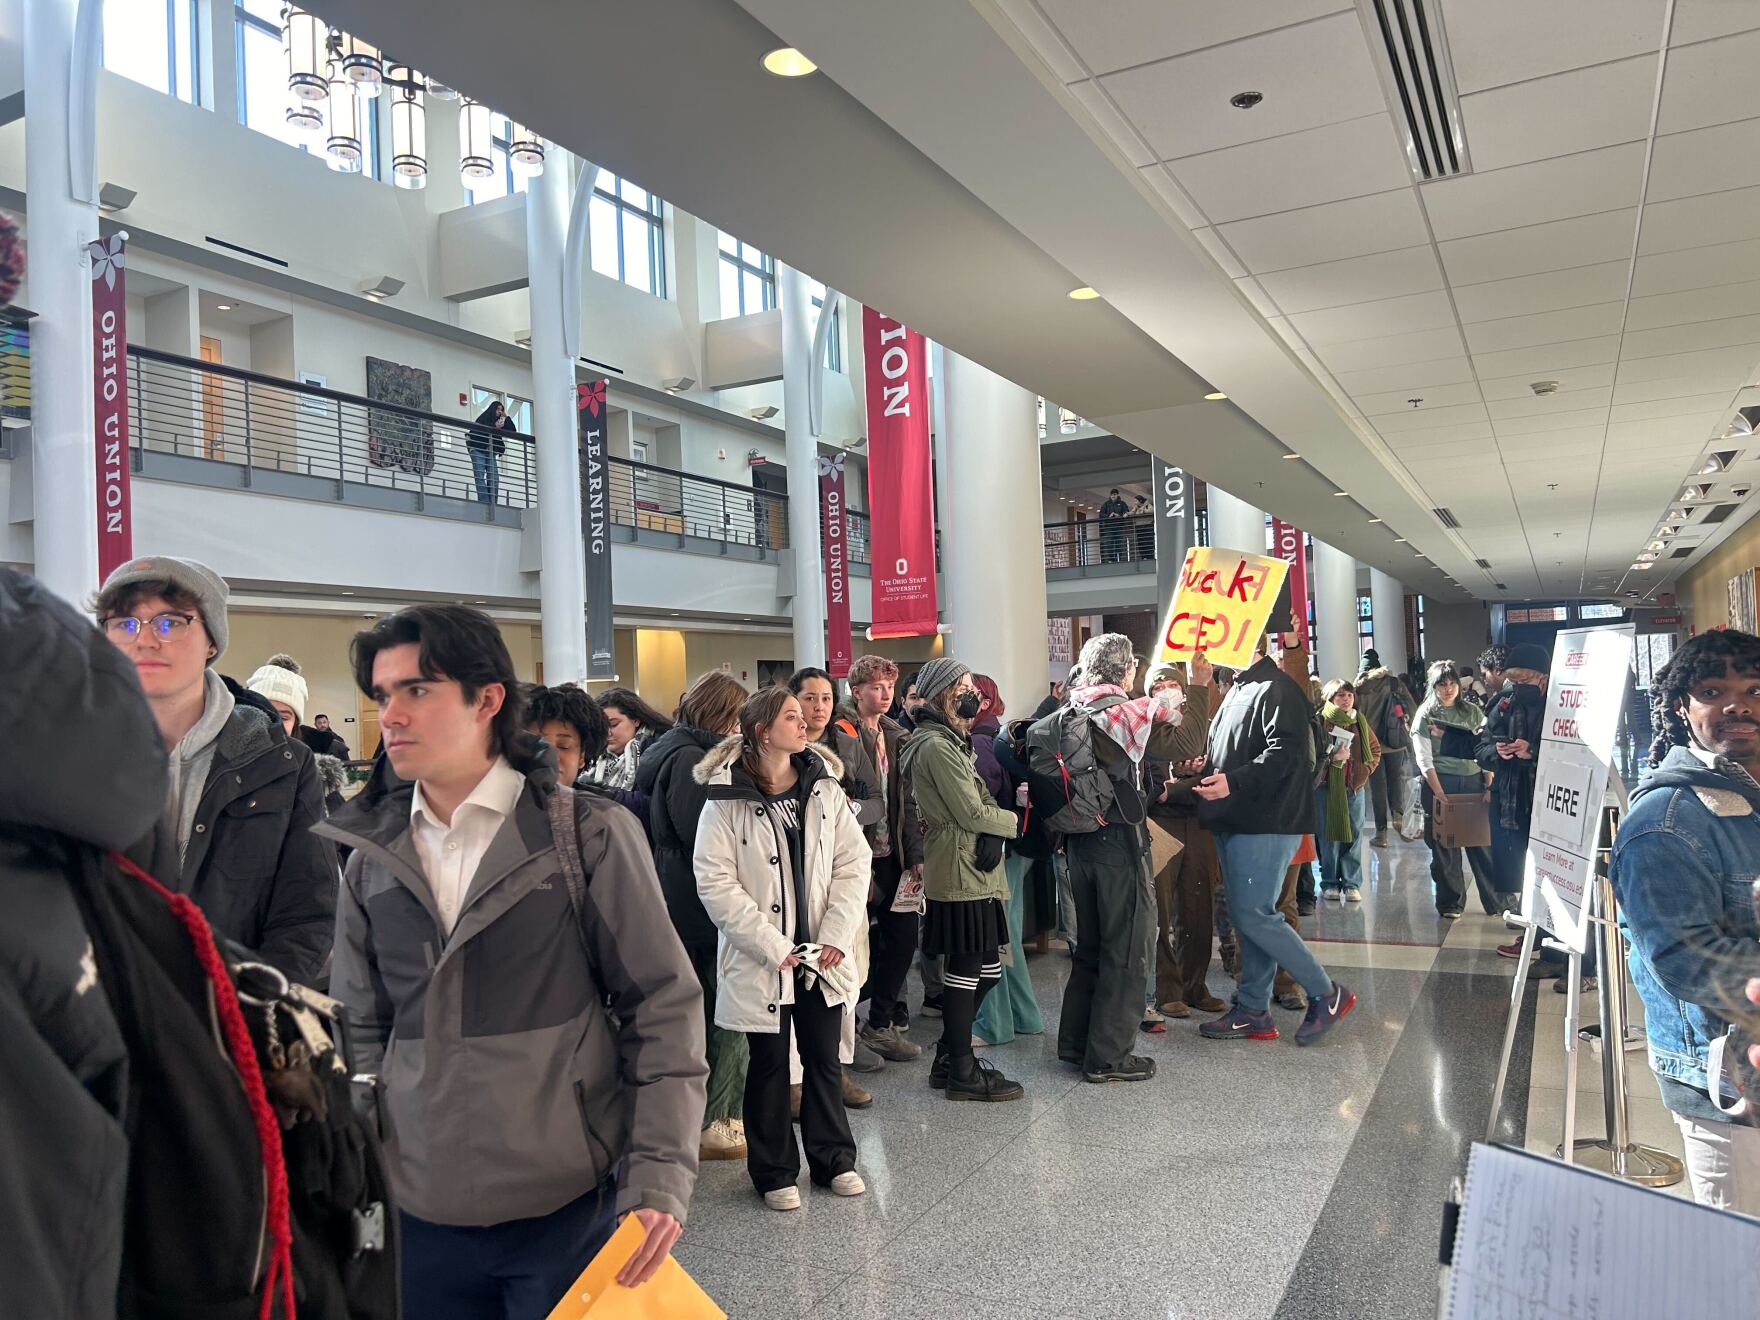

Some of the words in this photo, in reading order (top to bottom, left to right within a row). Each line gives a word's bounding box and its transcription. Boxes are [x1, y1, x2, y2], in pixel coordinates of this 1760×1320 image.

[101, 310, 118, 401] OHIO
[880, 314, 911, 416] ION
[104, 412, 122, 534] UNION
[587, 429, 604, 555] LEARNING
[827, 491, 841, 538] OHIO
[830, 543, 843, 603] UNION
[1546, 783, 1580, 818] HERE
[1542, 847, 1556, 864] Learn
[1556, 852, 1569, 869] More
[1568, 860, 1575, 872] at
